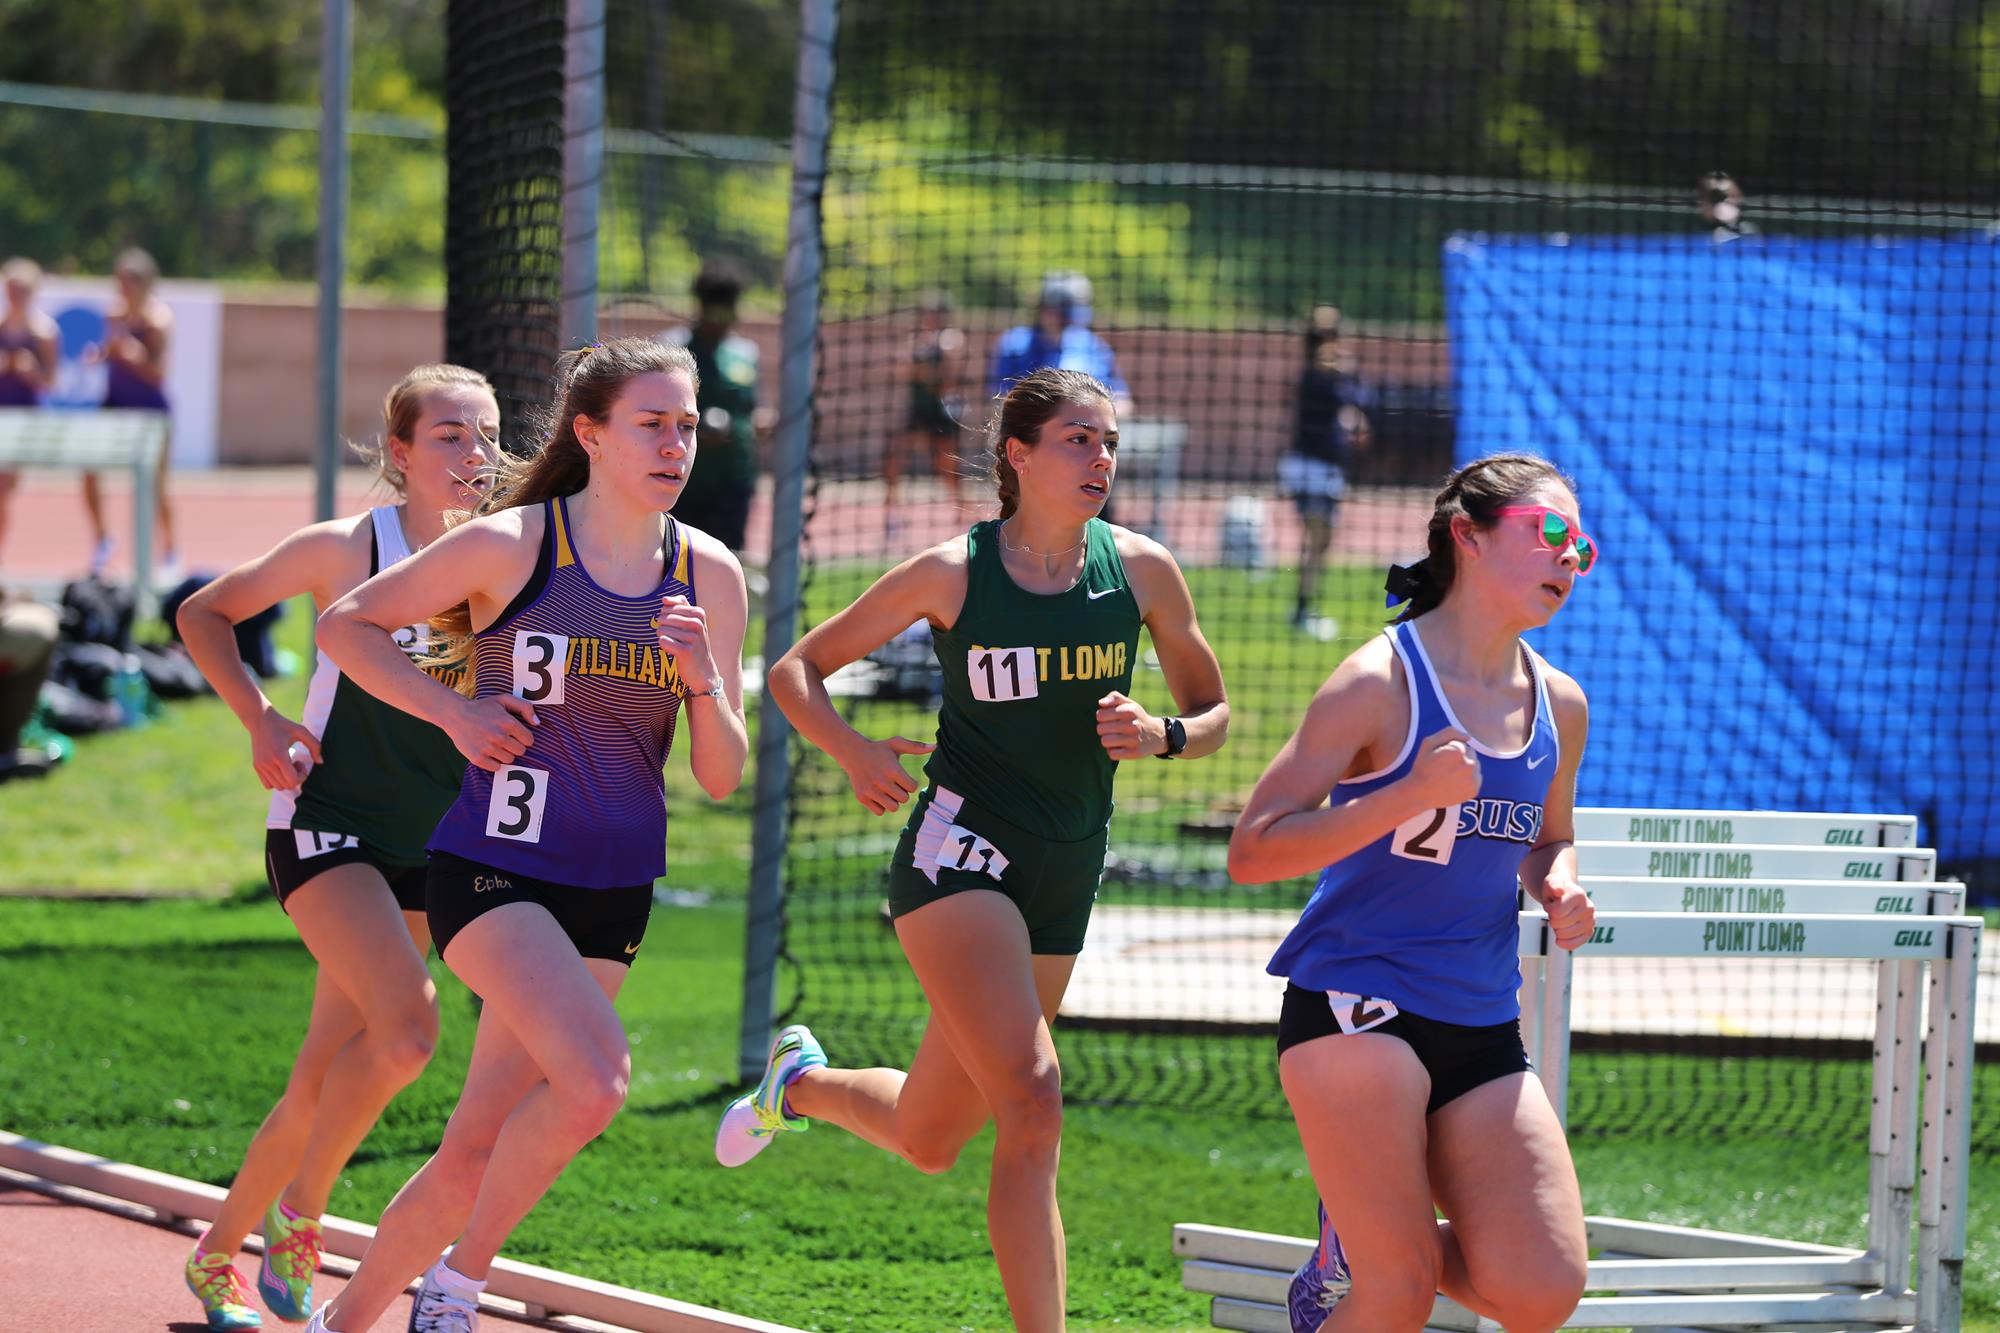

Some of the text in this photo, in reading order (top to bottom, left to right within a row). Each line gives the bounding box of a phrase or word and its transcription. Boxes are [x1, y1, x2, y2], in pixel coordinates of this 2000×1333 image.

[521, 635, 555, 701] 3
[1060, 641, 1127, 681] LOMA
[977, 651, 1021, 699] 11
[496, 770, 536, 837] 3
[1403, 808, 1447, 858] 2
[1628, 817, 1733, 843] POINT LOMA
[1824, 829, 1864, 845] GILL
[1648, 851, 1753, 879] POINT LOMA
[1843, 862, 1883, 878] GILL
[1681, 886, 1785, 913] POINT LOMA
[1875, 896, 1914, 913] GILL
[1588, 927, 1614, 944] ILL
[1703, 921, 1806, 952] POINT LOMA
[1893, 930, 1933, 947] GILL
